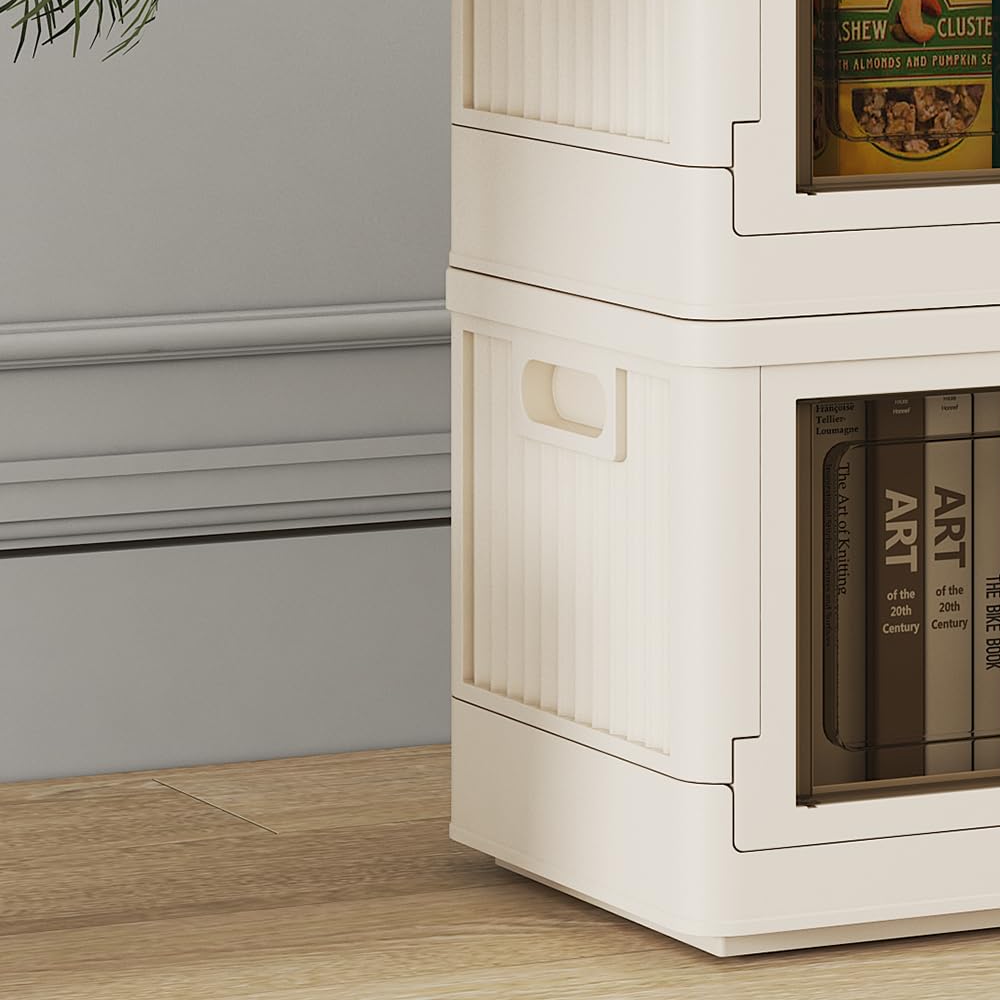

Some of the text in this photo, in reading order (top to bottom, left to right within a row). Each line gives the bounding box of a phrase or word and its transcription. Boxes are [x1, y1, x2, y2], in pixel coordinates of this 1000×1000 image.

[937, 16, 992, 39] CLUSTE
[853, 56, 901, 72] ALMONDS
[906, 55, 927, 68] AND
[932, 53, 977, 67] PUMPKIN
[816, 426, 859, 436] Loumagne
[837, 462, 850, 596] The Art of Knitting
[885, 488, 918, 573] ART
[934, 486, 966, 568] ART
[886, 588, 916, 601] of the
[935, 584, 964, 597] of the
[890, 605, 912, 617] 20th
[939, 601, 960, 613] 20th
[882, 622, 920, 635] Century
[931, 618, 968, 631] Century
[986, 574, 1000, 670] THE BIKE BOOK
